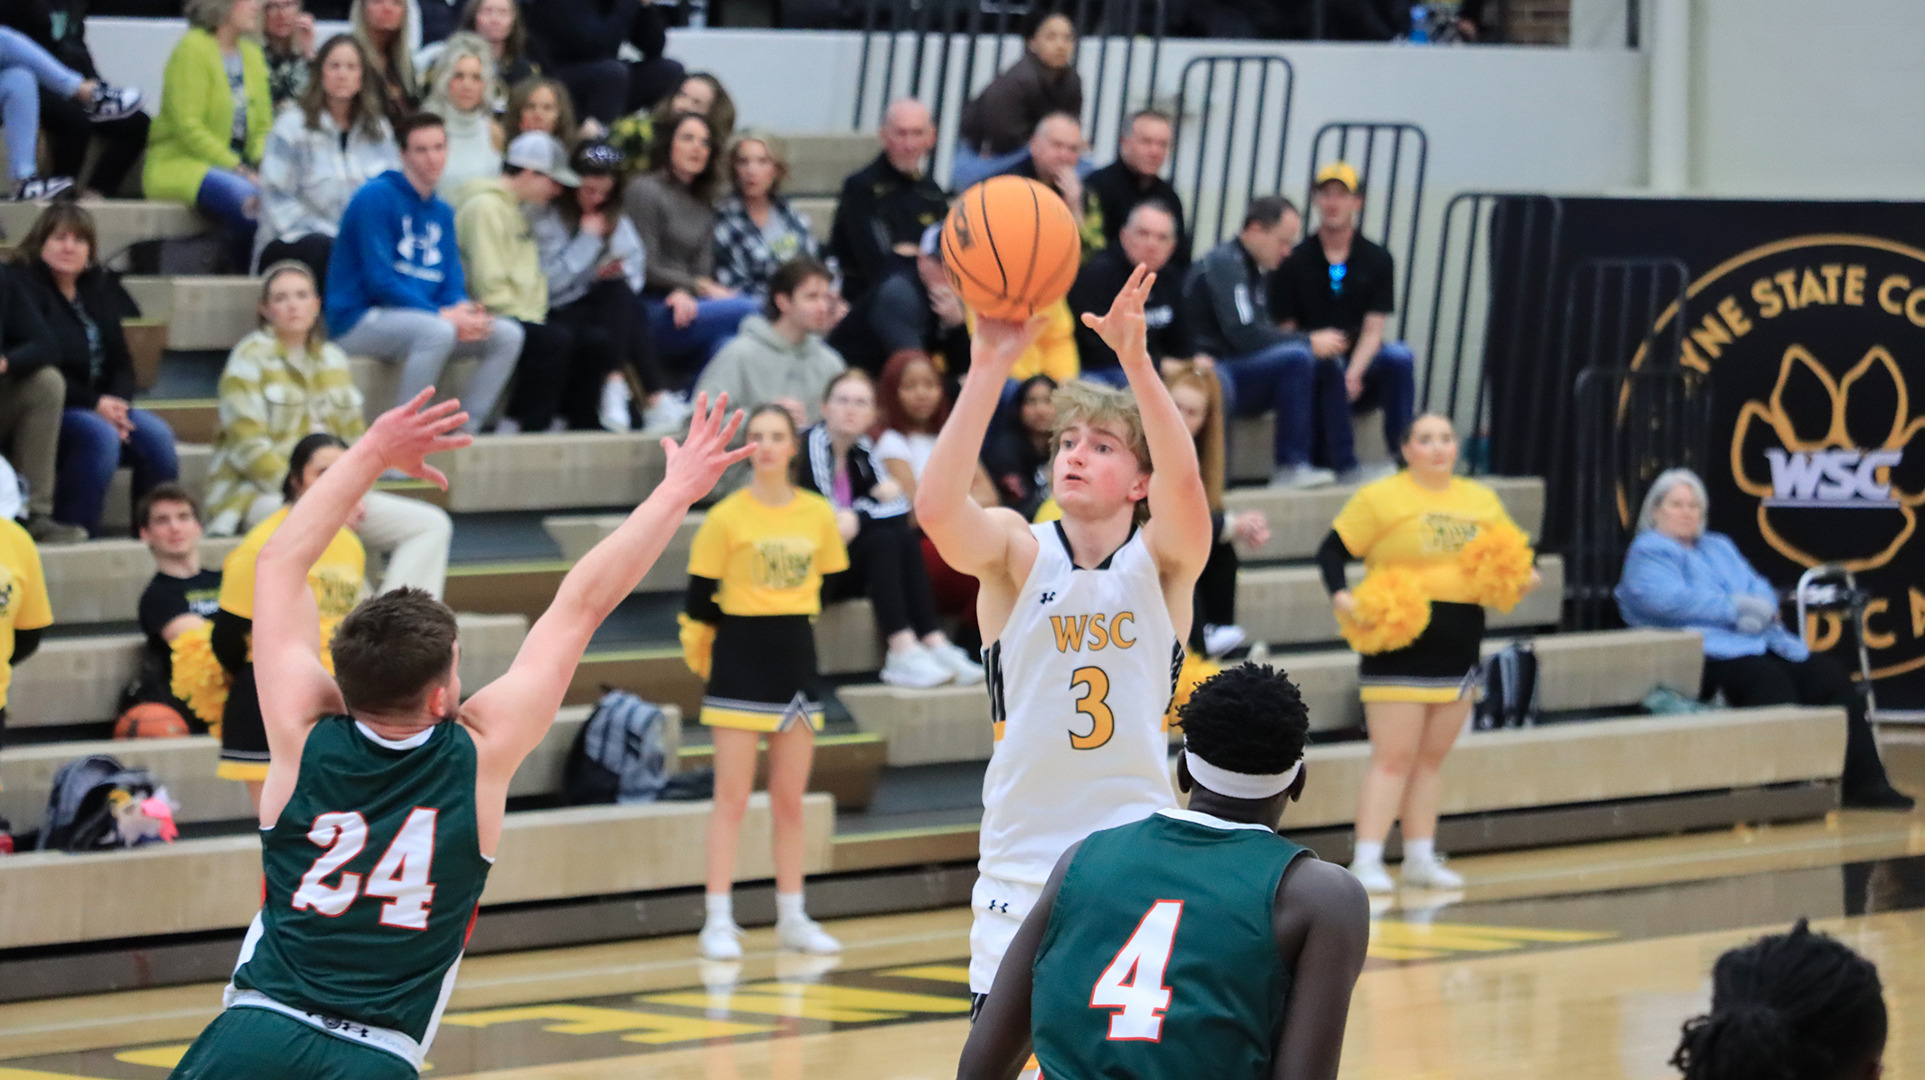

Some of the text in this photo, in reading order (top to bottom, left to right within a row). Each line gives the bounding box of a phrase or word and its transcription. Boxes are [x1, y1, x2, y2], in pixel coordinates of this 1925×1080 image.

[1680, 296, 1752, 374] YNE
[1751, 264, 1867, 319] STATE
[1764, 448, 1903, 501] WSC
[1050, 611, 1137, 653] WSC
[1068, 665, 1115, 751] 3
[291, 806, 440, 931] 24
[1088, 899, 1185, 1043] 4
